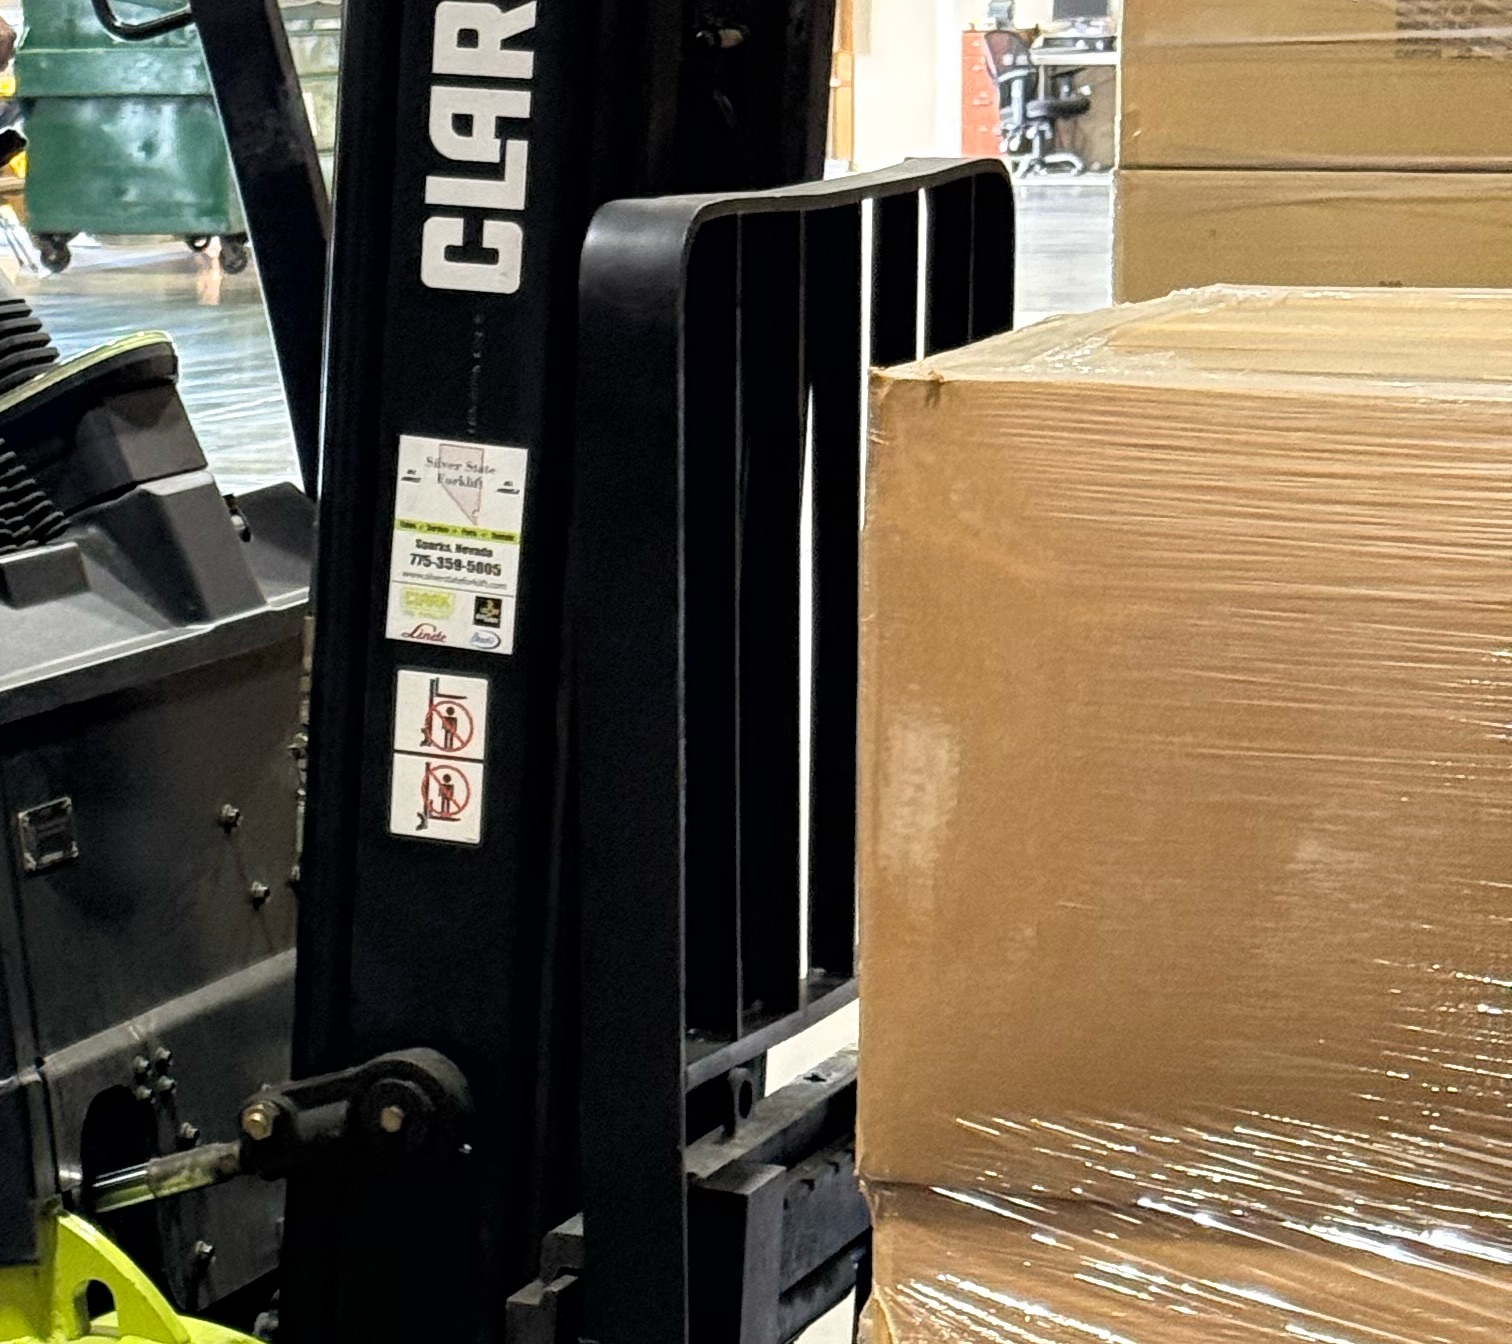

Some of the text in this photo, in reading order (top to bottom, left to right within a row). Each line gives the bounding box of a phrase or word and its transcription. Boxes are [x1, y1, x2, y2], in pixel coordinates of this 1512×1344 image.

[425, 455, 496, 475] Silver State
[401, 622, 448, 644] Linde
